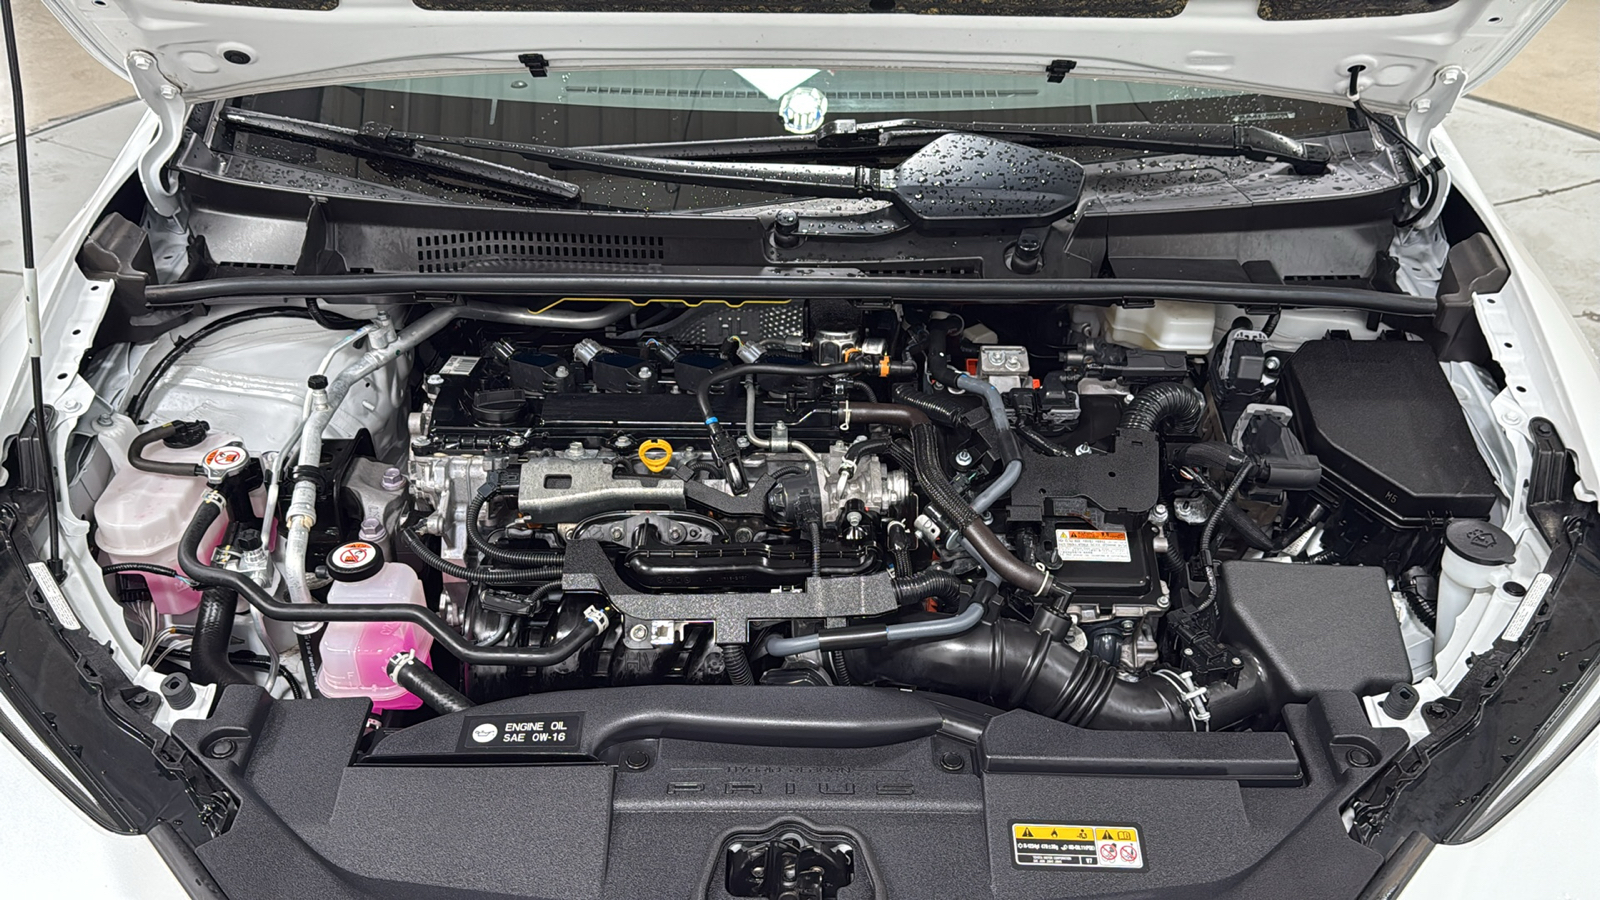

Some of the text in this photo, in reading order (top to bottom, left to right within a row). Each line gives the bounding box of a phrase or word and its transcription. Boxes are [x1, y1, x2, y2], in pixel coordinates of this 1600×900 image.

[505, 721, 567, 732] ENGINE OIL
[503, 732, 566, 742] SAE 0W-16
[666, 781, 915, 796] PRIUS
